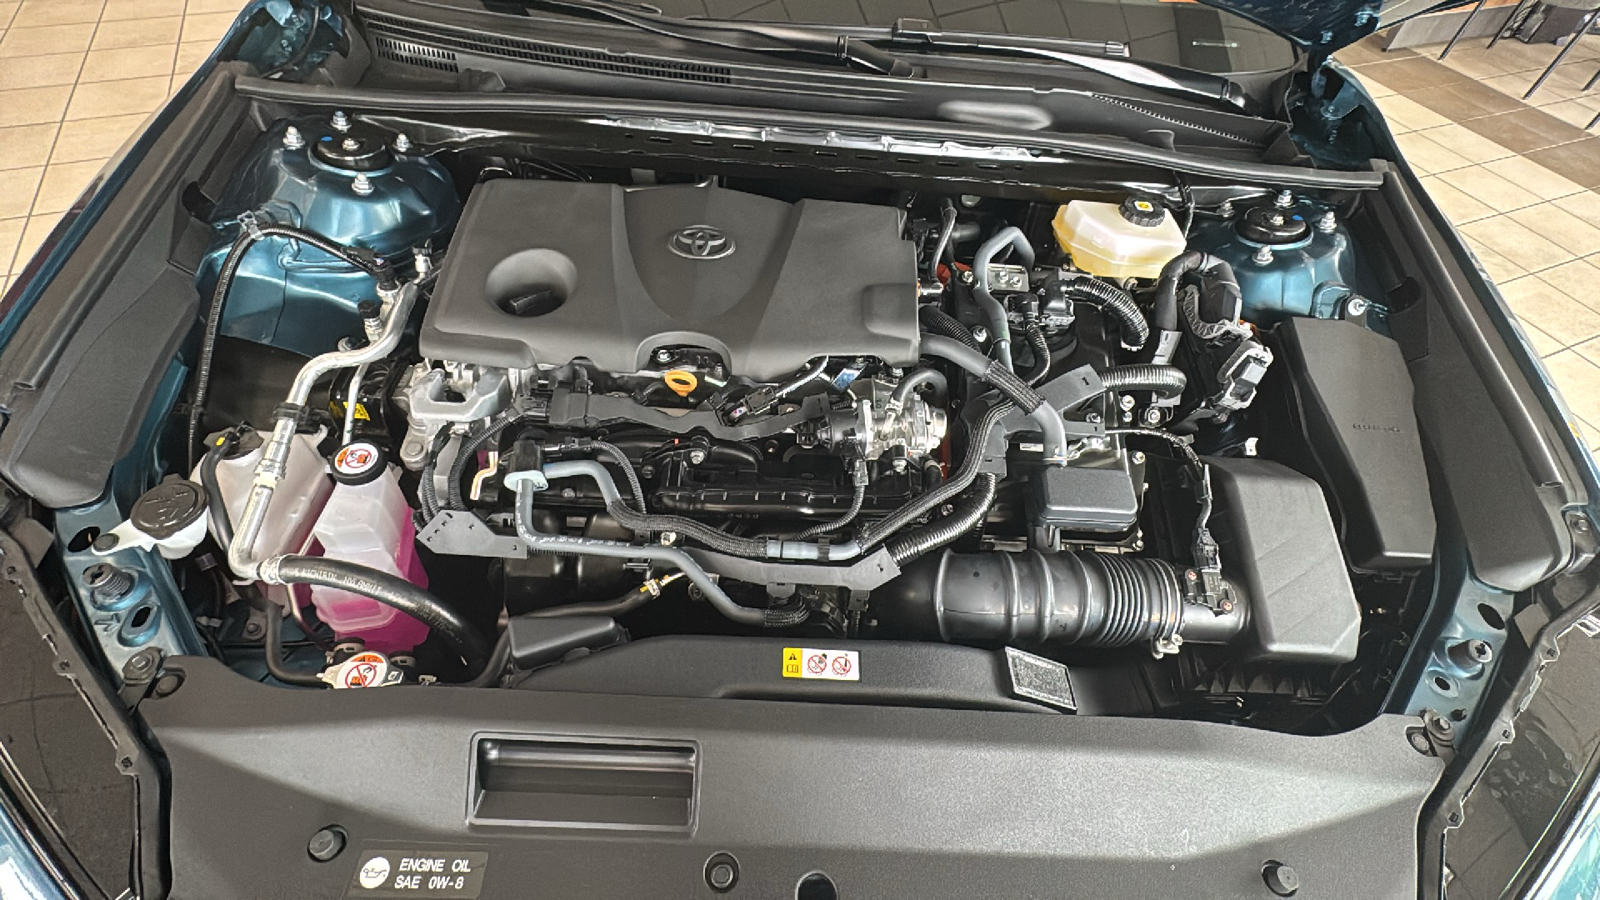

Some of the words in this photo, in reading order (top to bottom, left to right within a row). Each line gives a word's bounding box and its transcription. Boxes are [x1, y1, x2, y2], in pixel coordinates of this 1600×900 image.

[398, 858, 446, 873] ENGINE
[451, 859, 471, 873] OIL
[394, 875, 422, 889] SAE
[428, 876, 464, 889] 0W-8
